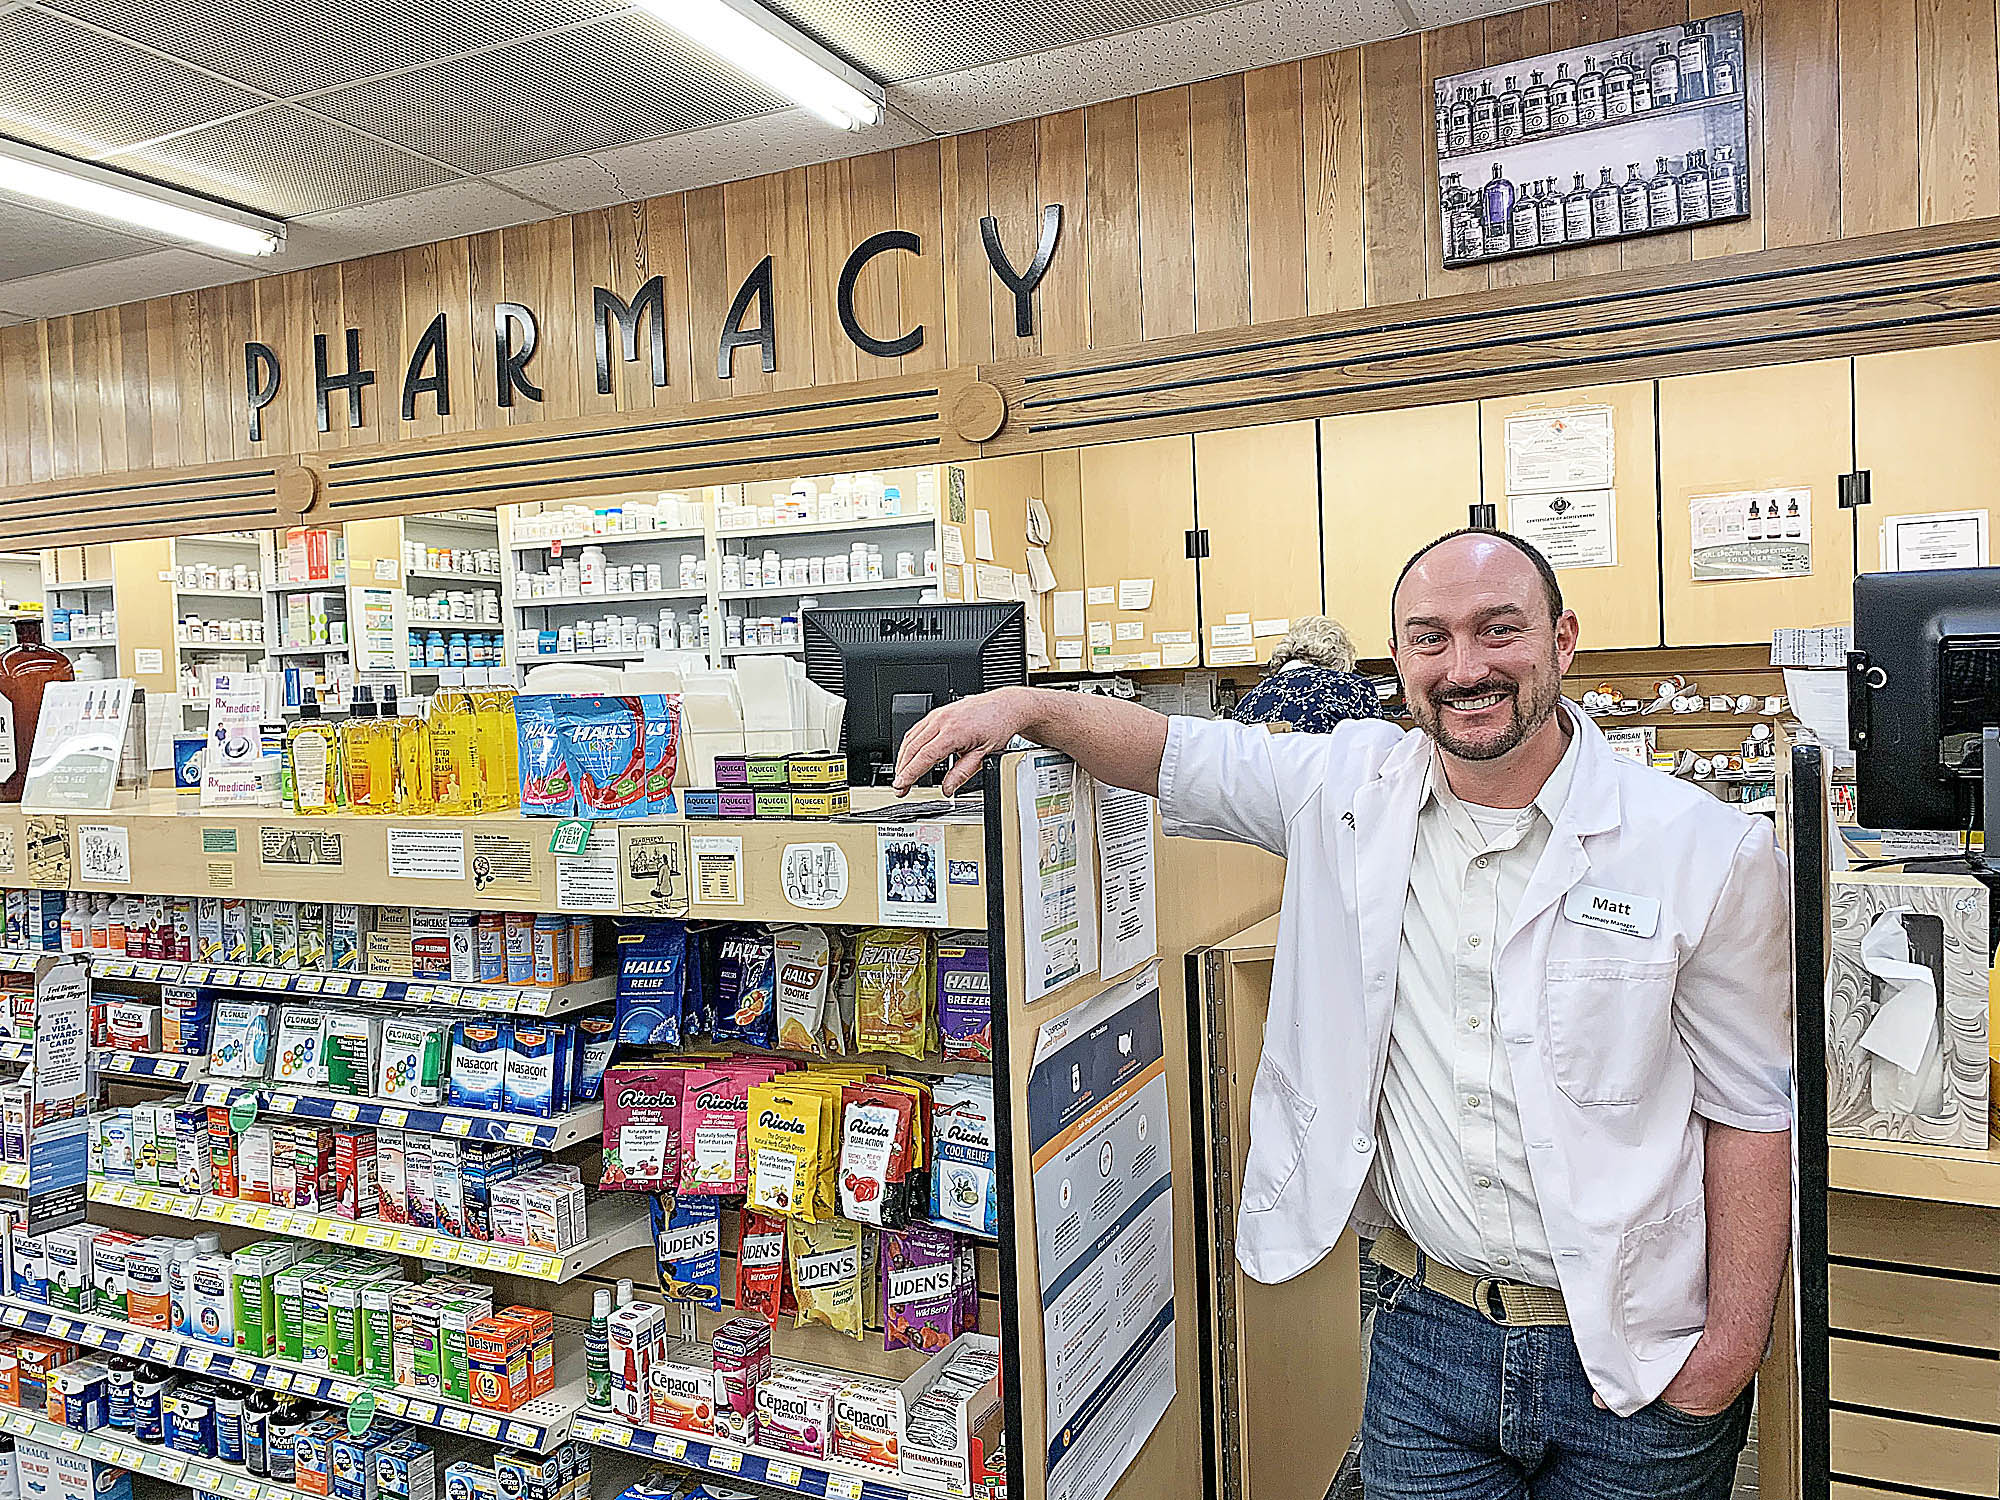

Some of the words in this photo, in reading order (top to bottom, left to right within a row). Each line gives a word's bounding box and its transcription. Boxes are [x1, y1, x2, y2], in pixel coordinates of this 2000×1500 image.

[245, 204, 1064, 441] PHARMACY
[1717, 549, 1750, 557] SPECTRUM
[1771, 546, 1798, 554] EXTRACT
[880, 617, 944, 638] DELL
[215, 698, 227, 708] Rx
[226, 701, 260, 714] medicine
[525, 722, 559, 741] HALL
[572, 724, 634, 743] HALLS
[1607, 732, 1640, 741] MYORISAN
[717, 765, 745, 773] AQUEGEL
[792, 765, 822, 773] AQUEGEL
[209, 777, 219, 787] Rx
[218, 781, 256, 792] medicine
[686, 797, 716, 805] AQUEGEL
[721, 797, 750, 805] AQUEGEL
[758, 797, 786, 805] AQUEGEL
[794, 797, 825, 805] AQUEGEL
[561, 826, 582, 835] NEW
[558, 836, 579, 845] ITEM
[384, 907, 401, 915] Nose
[1593, 896, 1631, 916] Matt
[381, 914, 403, 923] Better
[413, 917, 447, 928] NasalCEASE
[1581, 913, 1609, 925] Pharmacy
[1610, 919, 1636, 929] Manager
[372, 934, 388, 943] Nose
[370, 942, 390, 951] Better
[720, 941, 774, 960] HALLS
[373, 956, 389, 965] Nose
[859, 946, 921, 965] HALLS
[371, 963, 390, 972] Better
[624, 960, 672, 974] HALLS
[631, 978, 664, 988] RELIEF
[783, 967, 817, 986] HALLS
[946, 974, 990, 990] HALL
[165, 987, 196, 999] Mucinex
[784, 988, 810, 1001] SOOTHE
[947, 995, 990, 1006] BREEZER
[55, 1016, 69, 1025] $15
[113, 1009, 142, 1022] Mucinex
[220, 1010, 249, 1020] FLONASE
[287, 1015, 319, 1026] FLONASE
[40, 1029, 84, 1043] REWARDS
[388, 1030, 420, 1041] FLONASE
[50, 1038, 75, 1048] CARD
[456, 1057, 499, 1072] Nasacort
[508, 1061, 548, 1077] Nasacort
[618, 1089, 676, 1108] Ricola
[696, 1092, 748, 1111] Ricola
[647, 1109, 661, 1118] Berry
[759, 1110, 806, 1135] Ricola
[849, 1119, 889, 1138] Ricola
[378, 1135, 402, 1146] Mucinex
[775, 1133, 792, 1142] Original
[850, 1135, 864, 1144] DUAL
[864, 1137, 885, 1147] ACTION
[948, 1125, 989, 1147] Ricola
[406, 1140, 432, 1150] Mucinex
[778, 1141, 791, 1151] Cough
[791, 1144, 806, 1153] Drops
[431, 1149, 455, 1159] Mucinex
[483, 1146, 511, 1161] Mucinex
[944, 1144, 965, 1158] COOL
[966, 1149, 990, 1163] RELIEF
[491, 1193, 520, 1206] Mucinex
[526, 1199, 552, 1212] Mucinex
[660, 1230, 716, 1257] LUDEN'S
[742, 1241, 781, 1260] UDEN'S
[127, 1260, 160, 1274] Mucinex
[695, 1259, 716, 1271] Honey
[691, 1266, 716, 1279] Licorice
[193, 1275, 223, 1288] Mucinex
[888, 1273, 951, 1299] LUDEN'S
[832, 1286, 854, 1298] Honey
[832, 1295, 854, 1306] Lemon
[915, 1308, 930, 1318] Wild
[930, 1305, 949, 1316] Berry
[468, 1336, 504, 1353] Delsym
[714, 1338, 744, 1353] Chloraseptic
[20, 1361, 44, 1374] DayQuil
[482, 1377, 494, 1389] 12
[107, 1385, 131, 1398] NyQuil
[173, 1415, 200, 1431] NyQuil
[269, 1434, 295, 1446] NyQuil
[18, 1444, 50, 1460] ALKALOL
[55, 1456, 88, 1473] ALKALOL
[902, 1449, 939, 1464] FISHERMAN'S
[940, 1456, 963, 1469] FRIEND
